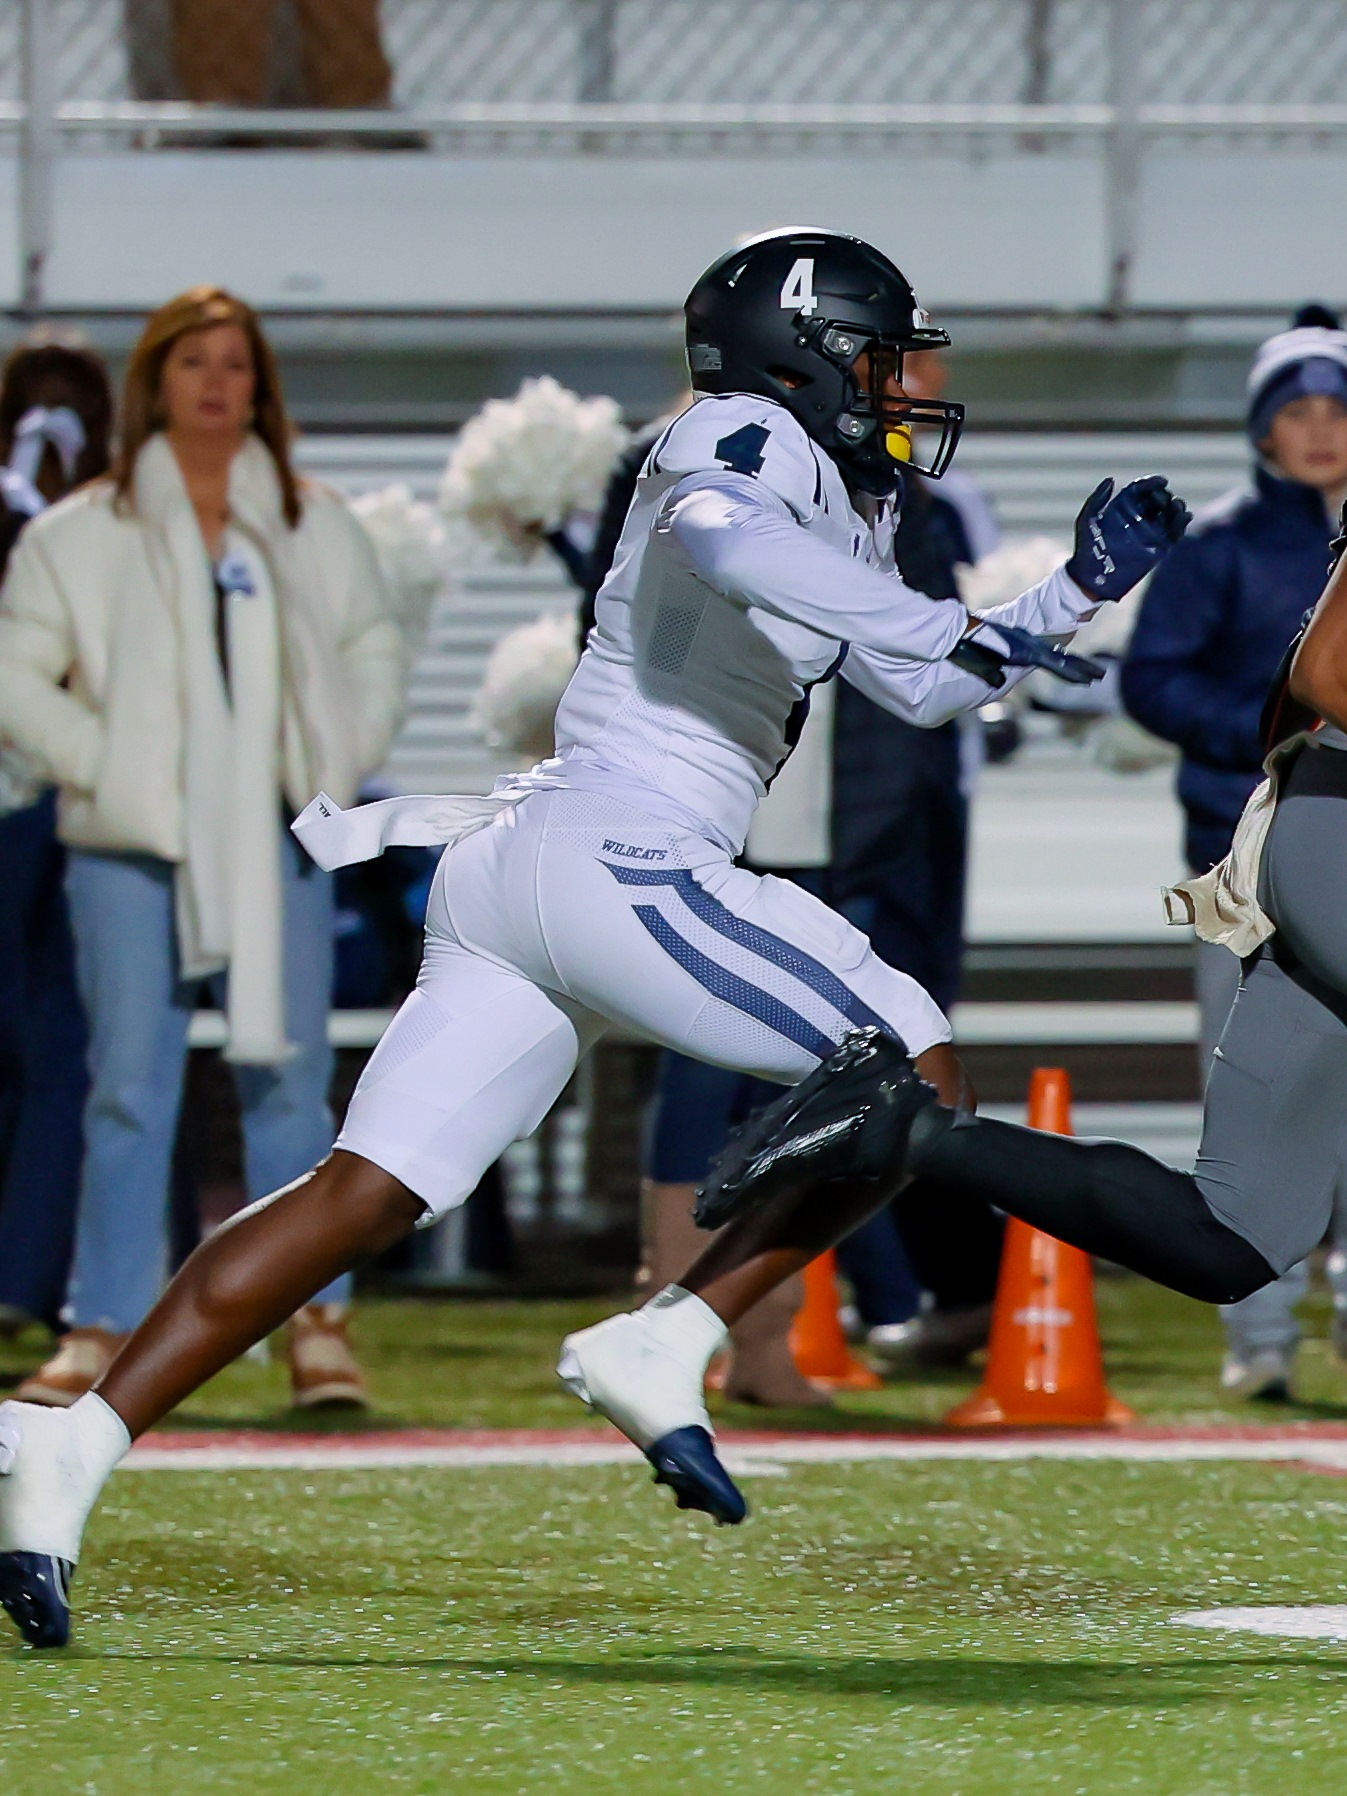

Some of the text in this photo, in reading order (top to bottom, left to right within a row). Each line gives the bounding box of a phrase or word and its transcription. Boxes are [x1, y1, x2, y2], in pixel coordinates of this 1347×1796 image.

[780, 258, 818, 316] 4
[714, 422, 772, 479] 4
[602, 838, 668, 861] WILDCATS
